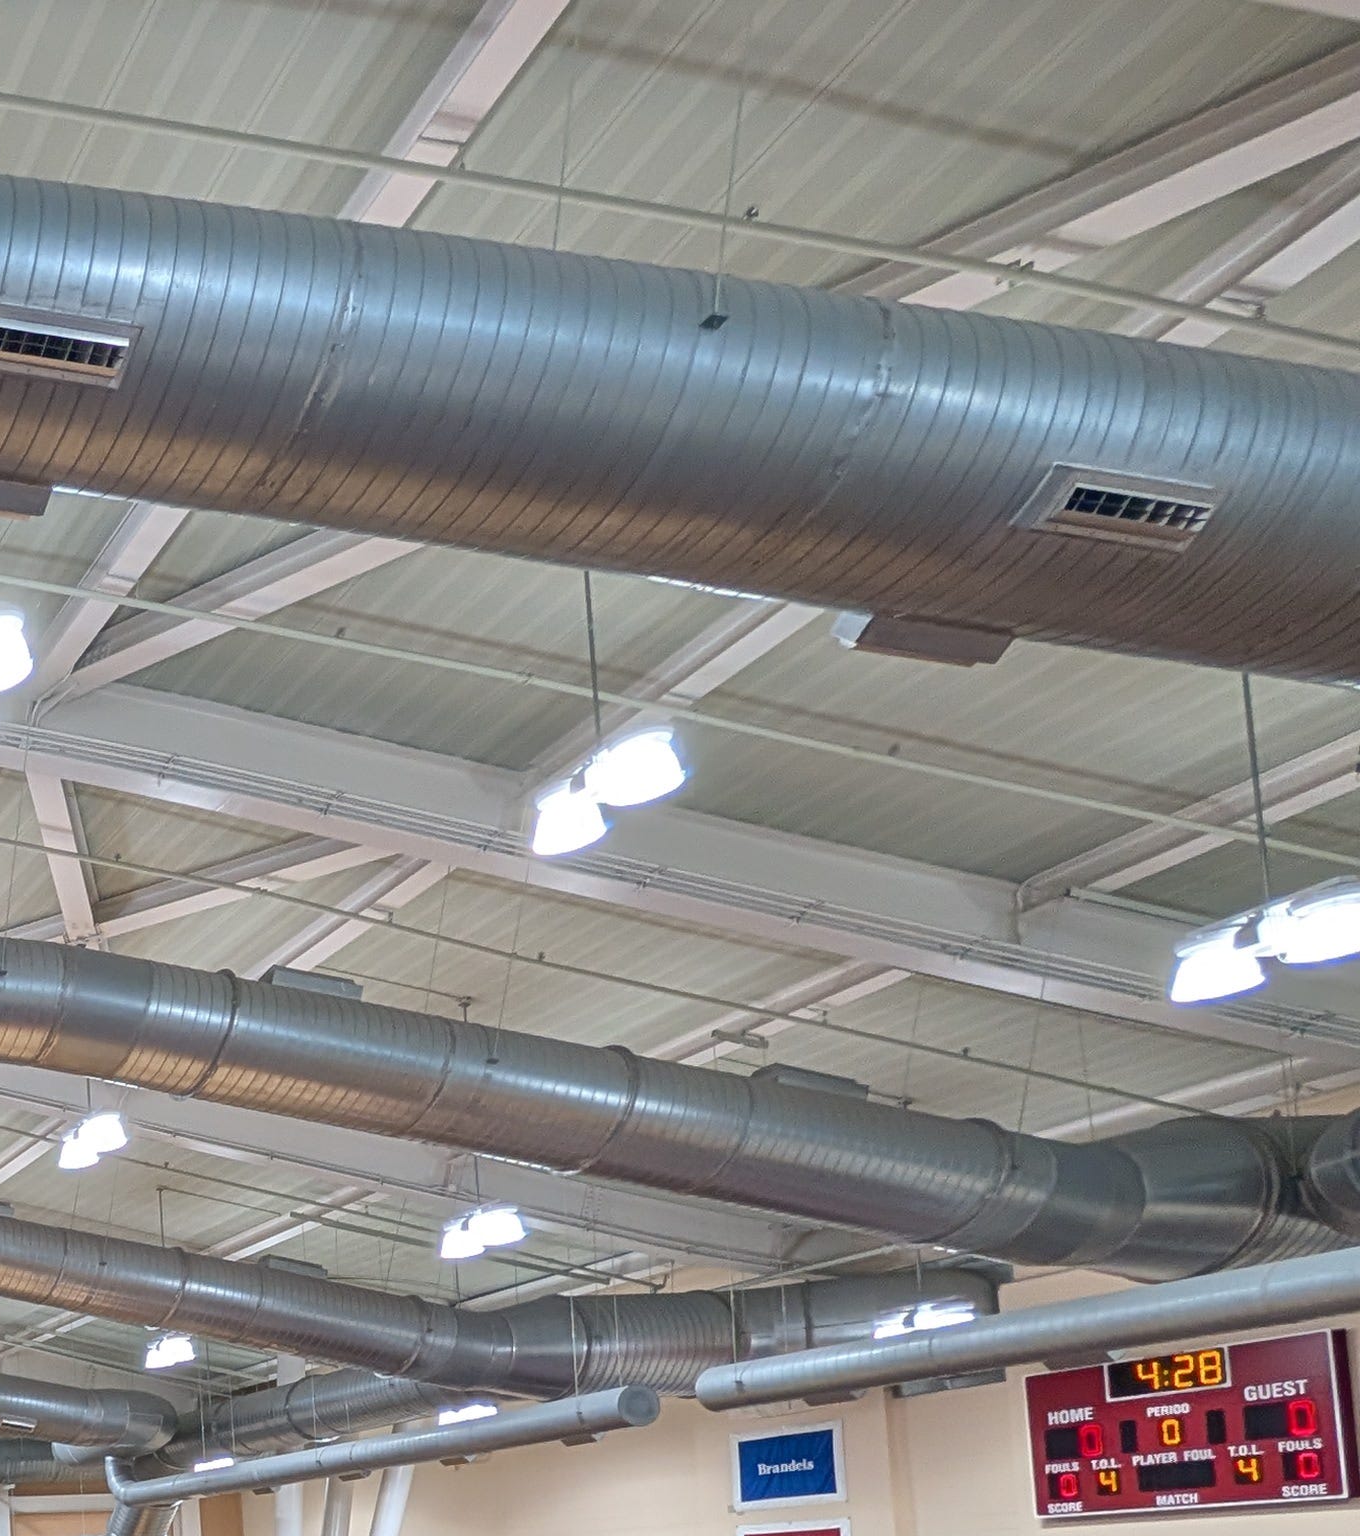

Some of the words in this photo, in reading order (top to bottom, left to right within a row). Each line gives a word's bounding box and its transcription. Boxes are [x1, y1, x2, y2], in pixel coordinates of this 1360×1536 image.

[1135, 1348, 1223, 1390] 4:28
[1243, 1379, 1309, 1402] GUEST
[1047, 1406, 1094, 1426] HOME
[1146, 1403, 1191, 1418] PERIOD
[1289, 1399, 1317, 1437] 0
[1077, 1423, 1104, 1457] 0
[1161, 1418, 1181, 1446] 0
[1228, 1444, 1264, 1458] T.O.L.
[1278, 1438, 1322, 1453] FOULS
[1045, 1459, 1080, 1474] FOULS
[1090, 1459, 1122, 1471] T.O.L.
[1132, 1451, 1177, 1466] PLAYER
[1183, 1448, 1216, 1462] FOUL
[1297, 1452, 1319, 1479] 0
[757, 1458, 815, 1476] Brandeis
[1237, 1458, 1259, 1482] 4
[1059, 1473, 1077, 1498] 0
[1099, 1470, 1118, 1493] 4
[1281, 1483, 1328, 1497] SCORE
[1047, 1501, 1083, 1514] SCORE
[1156, 1492, 1198, 1506] MATCH
